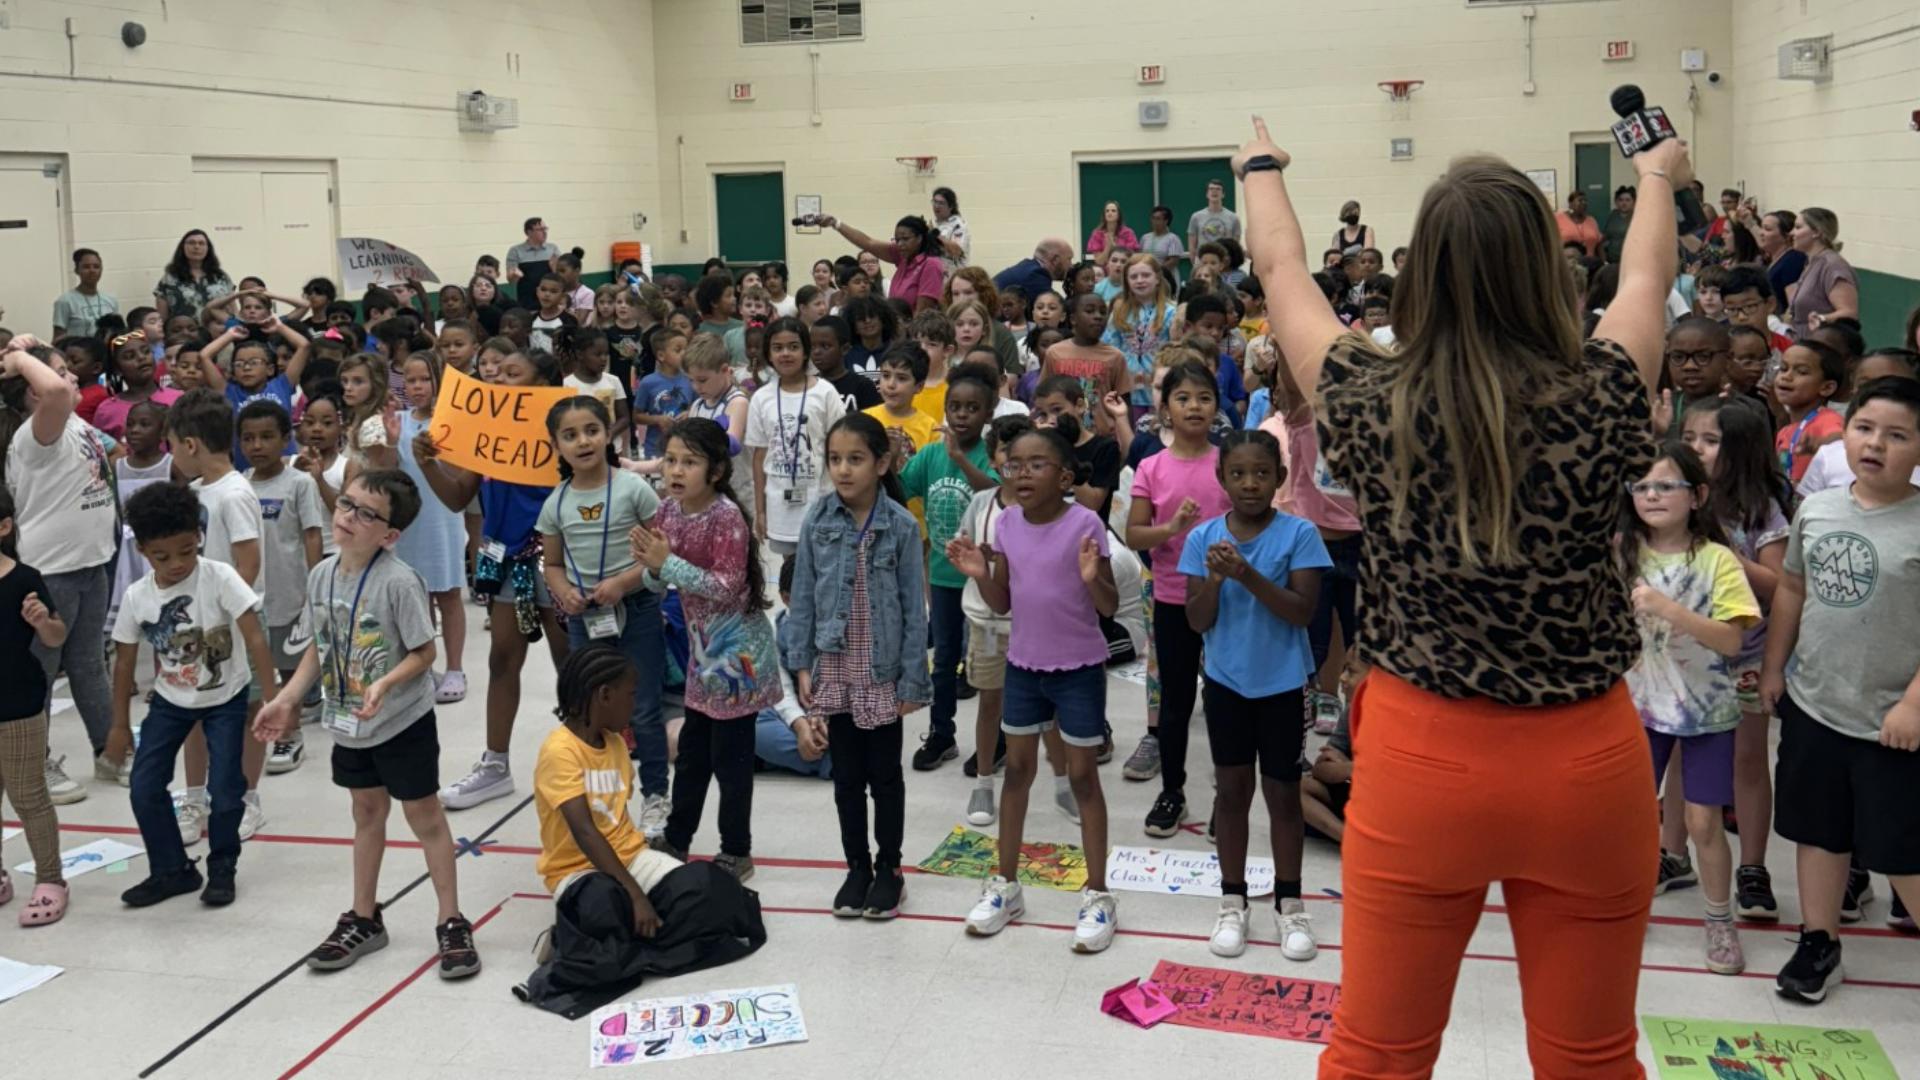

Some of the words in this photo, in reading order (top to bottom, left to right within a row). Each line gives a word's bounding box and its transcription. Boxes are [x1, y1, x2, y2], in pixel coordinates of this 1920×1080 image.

[1607, 41, 1629, 57] EXIT
[1141, 66, 1160, 81] EXIT
[1631, 123, 1643, 139] 2
[349, 252, 415, 270] LEARNING
[450, 378, 533, 422] LOVE
[434, 423, 454, 452] 2
[474, 432, 554, 469] READ
[1110, 868, 1155, 882] Class
[1161, 872, 1203, 886] Loves
[599, 992, 792, 1037] SUCCEED
[643, 1034, 671, 1057] 2
